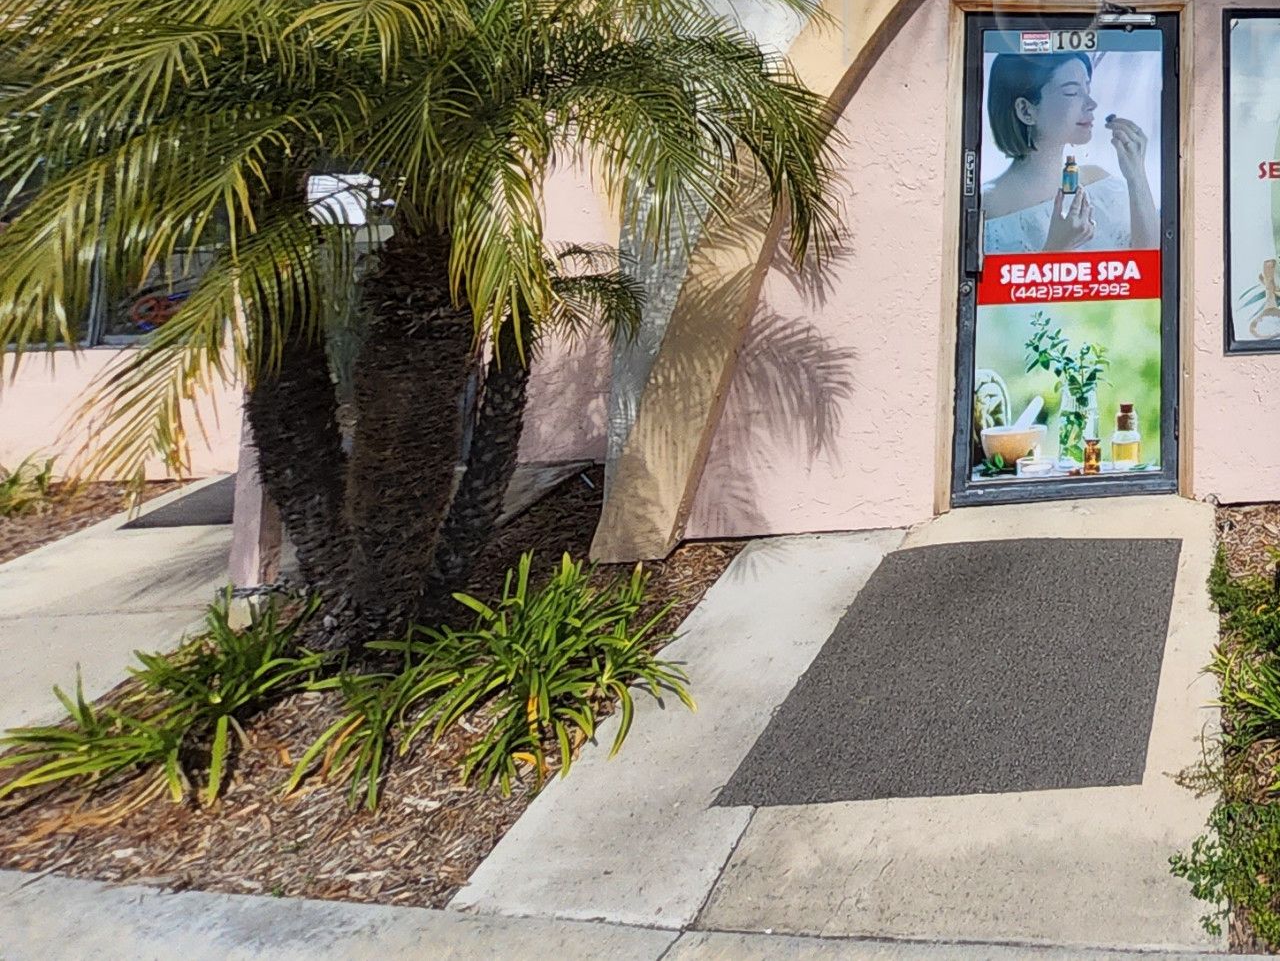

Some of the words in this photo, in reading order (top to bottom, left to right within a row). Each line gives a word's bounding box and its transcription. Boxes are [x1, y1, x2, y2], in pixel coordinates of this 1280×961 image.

[1057, 31, 1096, 50] 103
[1000, 262, 1092, 284] SEASIDE
[1097, 260, 1141, 280] SPA
[1010, 283, 1130, 301] (442)375-7992
